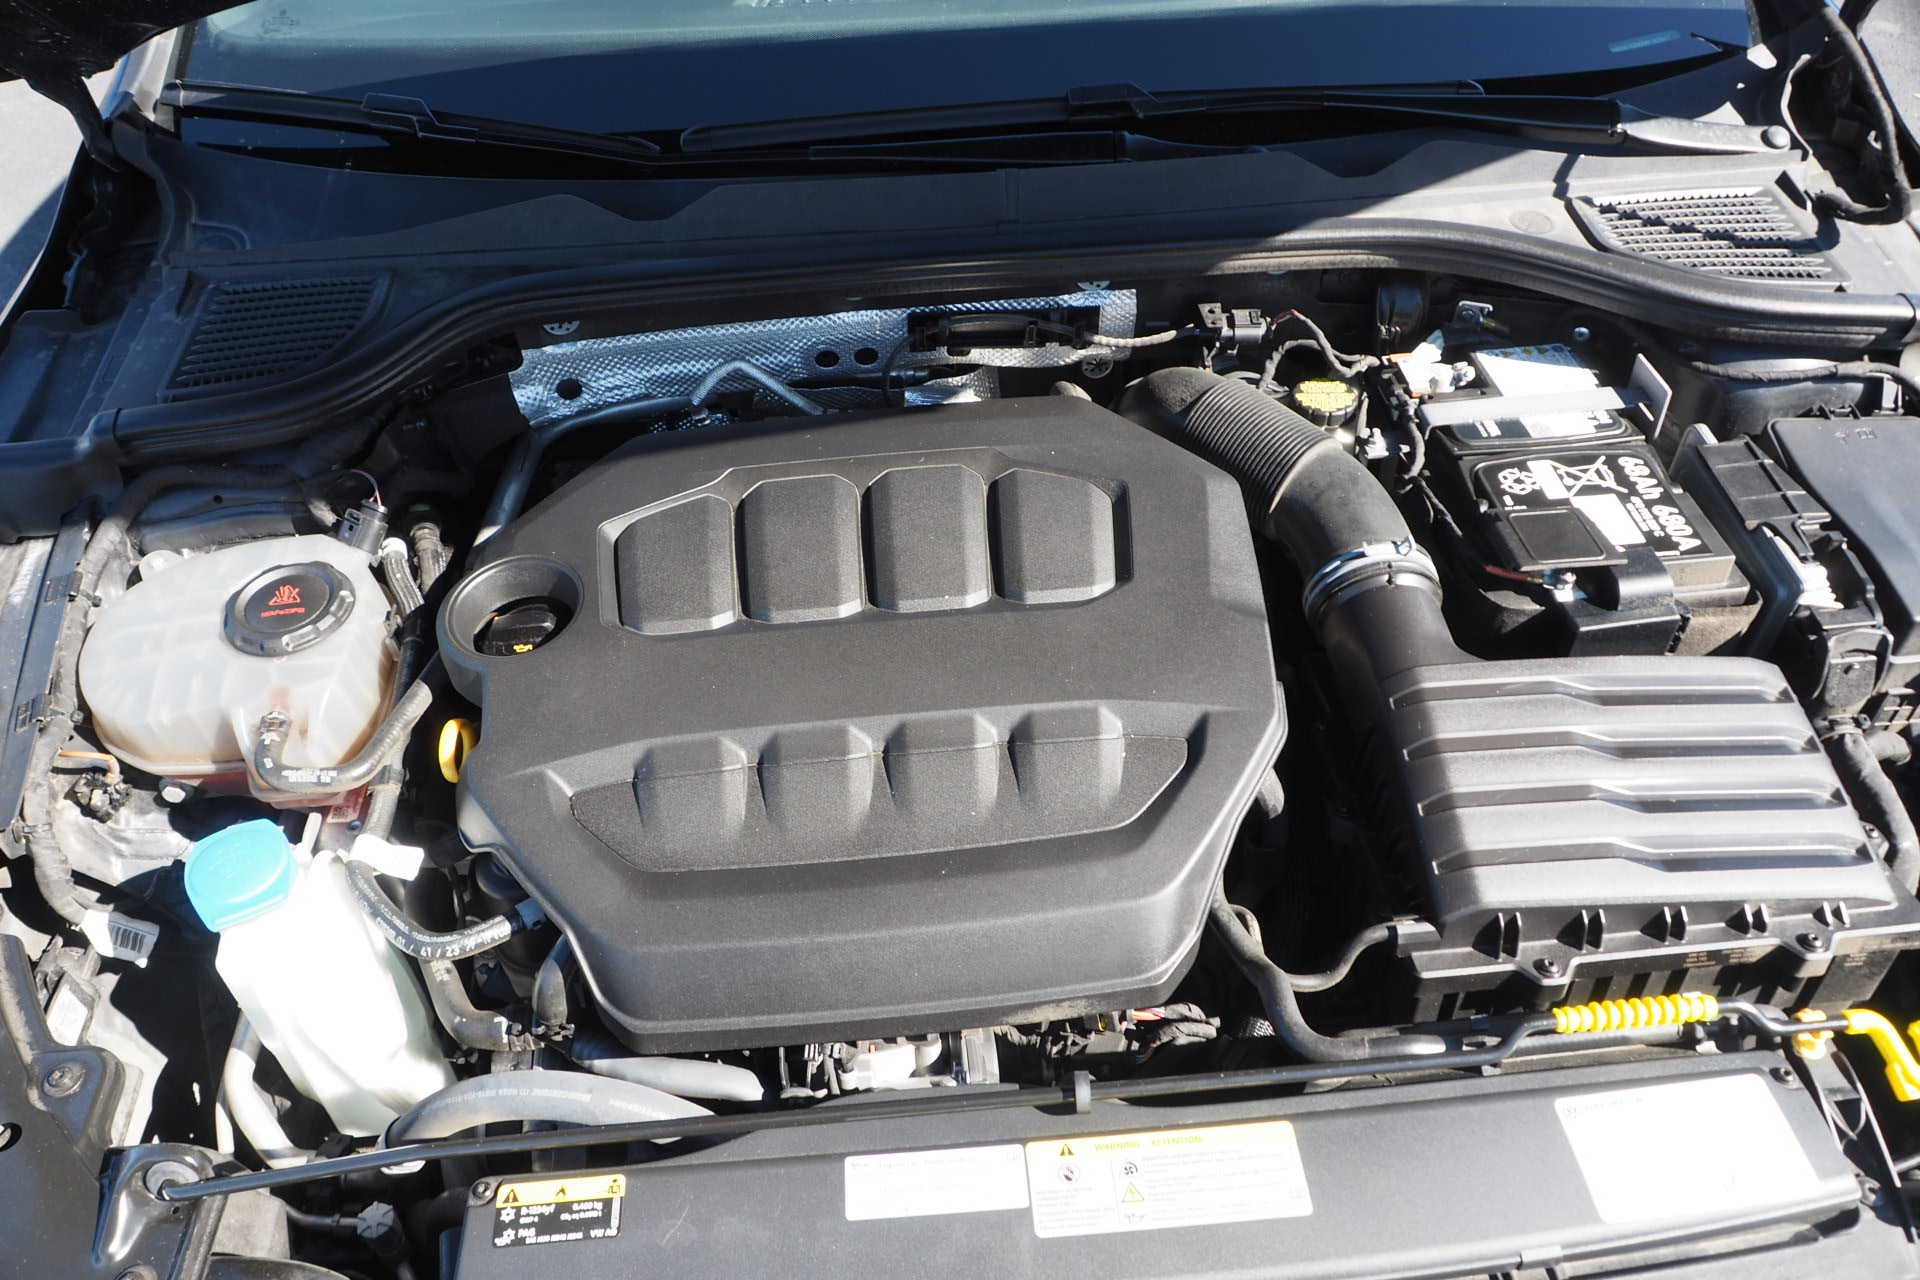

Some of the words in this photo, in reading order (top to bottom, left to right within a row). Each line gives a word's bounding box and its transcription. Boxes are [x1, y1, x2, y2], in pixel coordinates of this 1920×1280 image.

[1618, 456, 1664, 499] 68Ah
[1651, 504, 1702, 551] 680A
[446, 945, 460, 957] 23
[1094, 1141, 1141, 1152] WARNING
[1150, 1135, 1203, 1147] ATTENTION
[518, 1227, 536, 1238] PAG
[590, 1229, 605, 1238] VW
